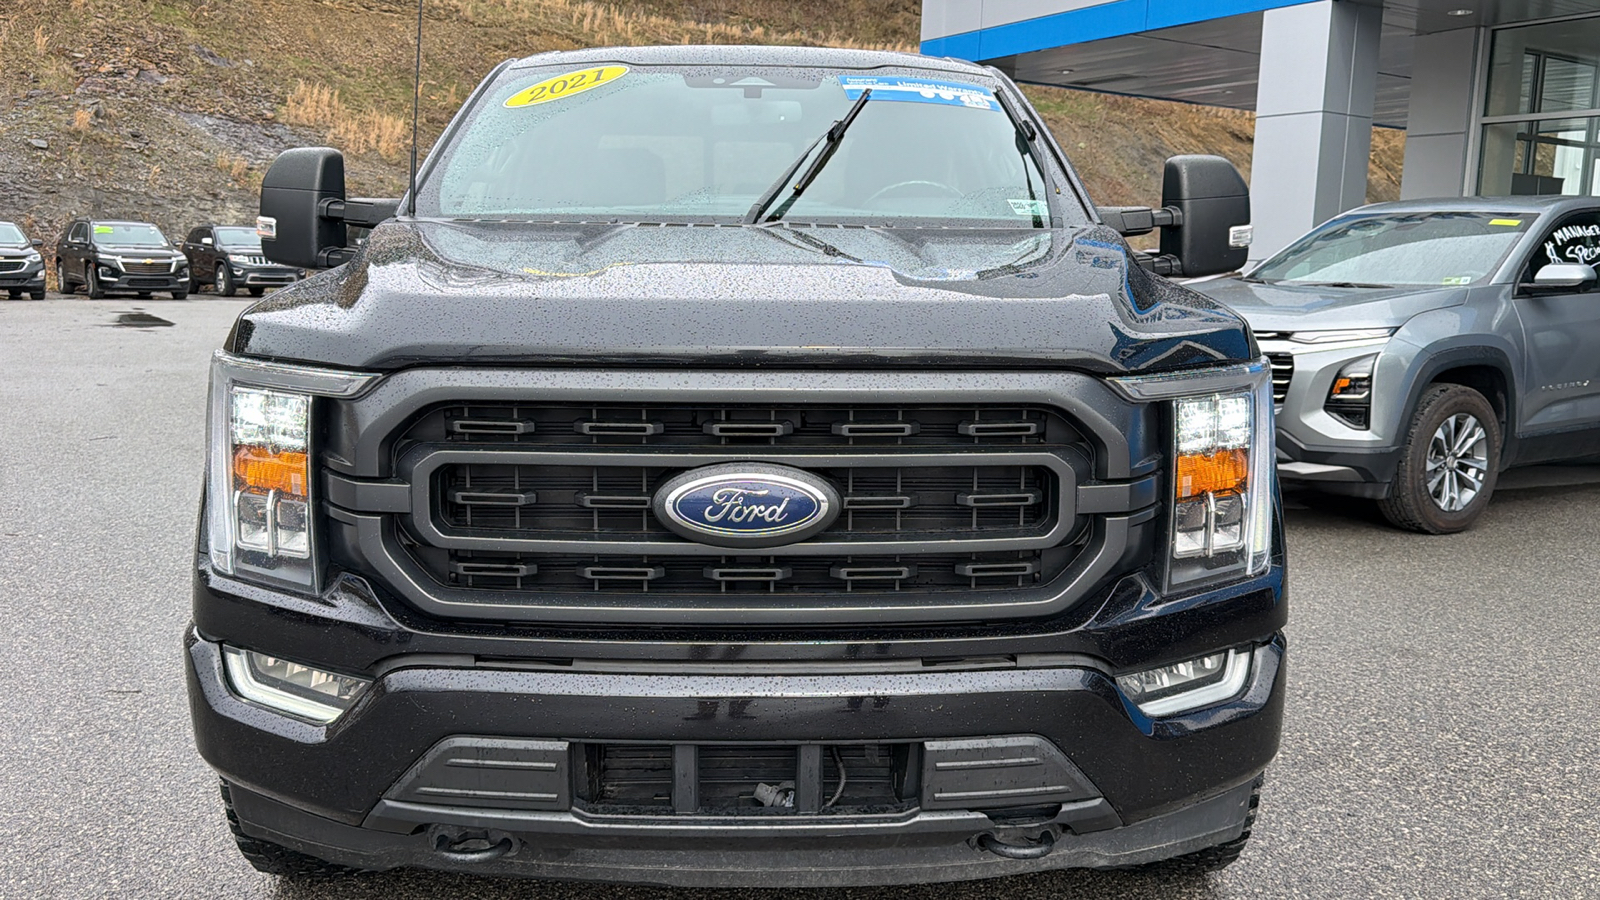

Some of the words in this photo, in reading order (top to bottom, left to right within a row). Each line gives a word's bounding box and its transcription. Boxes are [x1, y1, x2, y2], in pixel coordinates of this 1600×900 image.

[528, 69, 605, 103] 2021
[896, 81, 936, 89] Limited
[937, 84, 984, 96] Warranty
[703, 487, 790, 523] Ford
